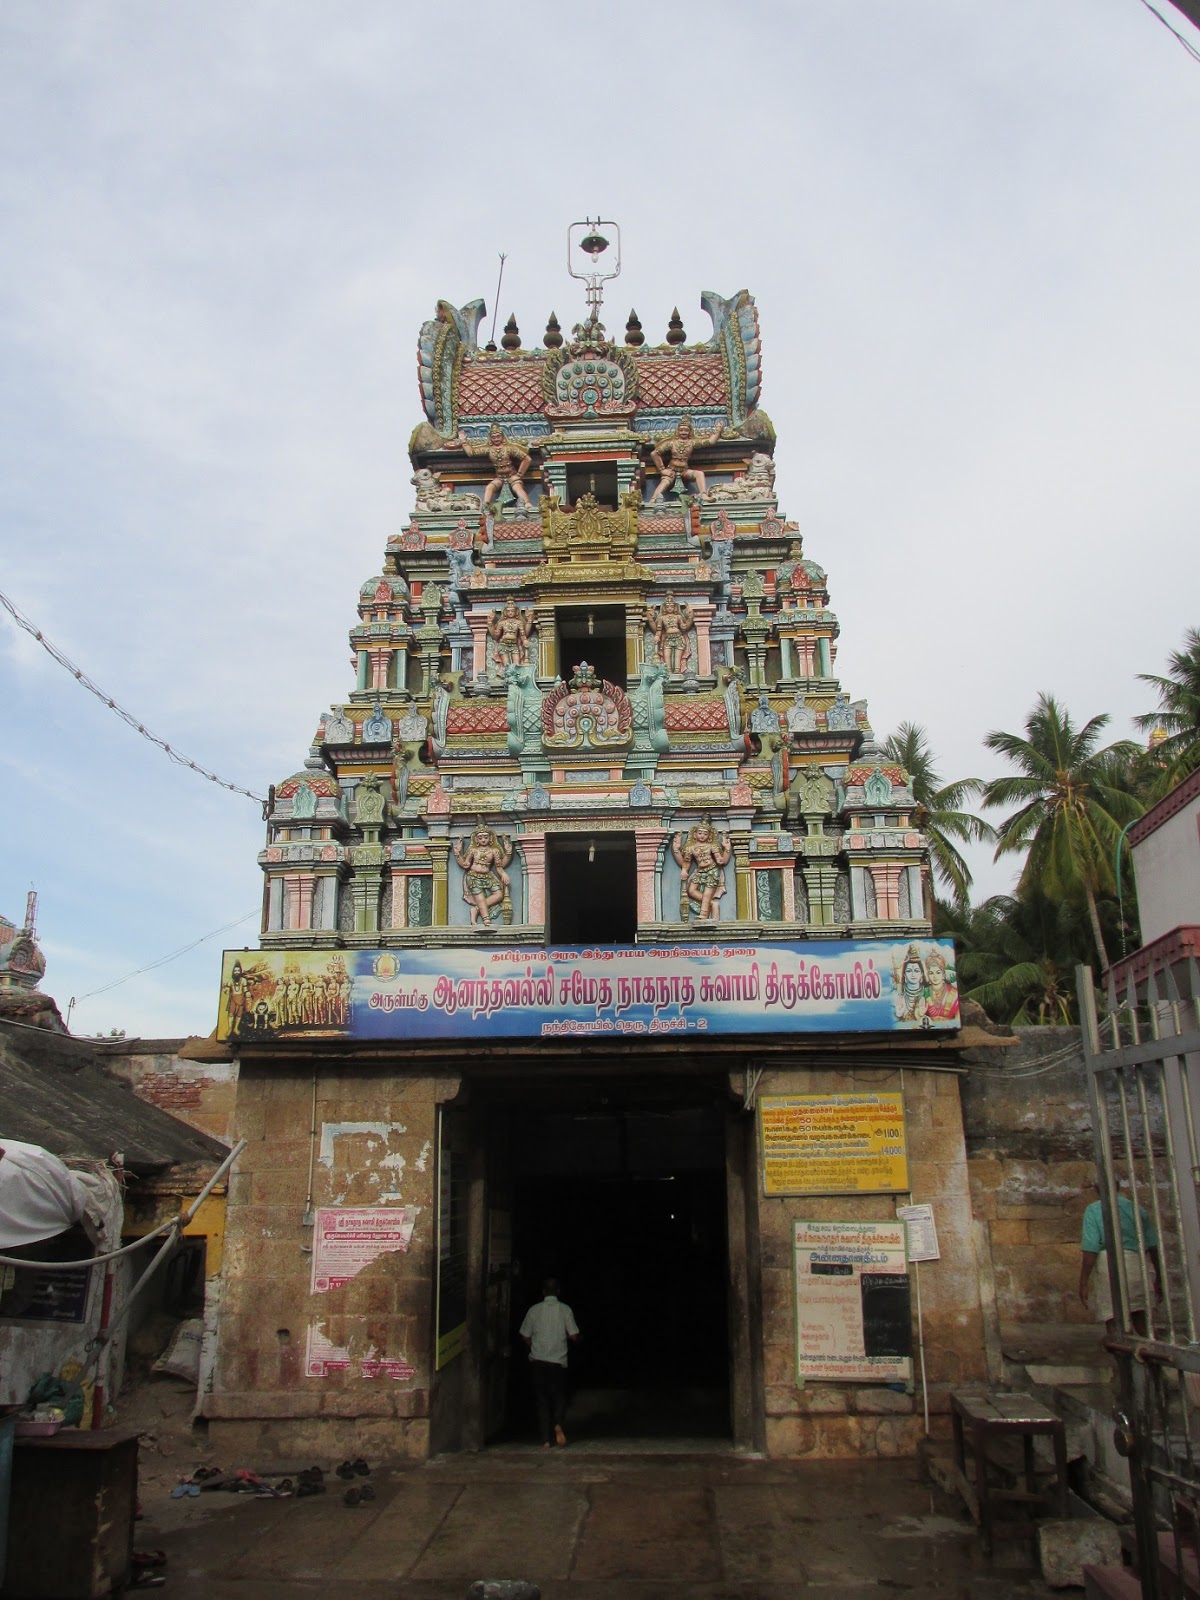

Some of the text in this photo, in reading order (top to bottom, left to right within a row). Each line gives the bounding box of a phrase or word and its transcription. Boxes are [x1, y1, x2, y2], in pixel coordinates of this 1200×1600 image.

[491, 945, 756, 962] தமிழ்நாடு அரசு இந்து சமய அறநிலையத் துறை
[369, 987, 429, 1012] அருள்மிகு
[433, 965, 555, 1019] ஆனந்தவல்லி
[559, 970, 613, 1016] சமேத
[615, 975, 695, 1016] நாகநாத
[699, 961, 760, 1002] சுவாமி
[764, 958, 881, 1010] திருக்கோயில்
[541, 1019, 613, 1035] நந்திகோயில்
[649, 1018, 687, 1033] திருச்சி
[697, 1019, 708, 1030] 2
